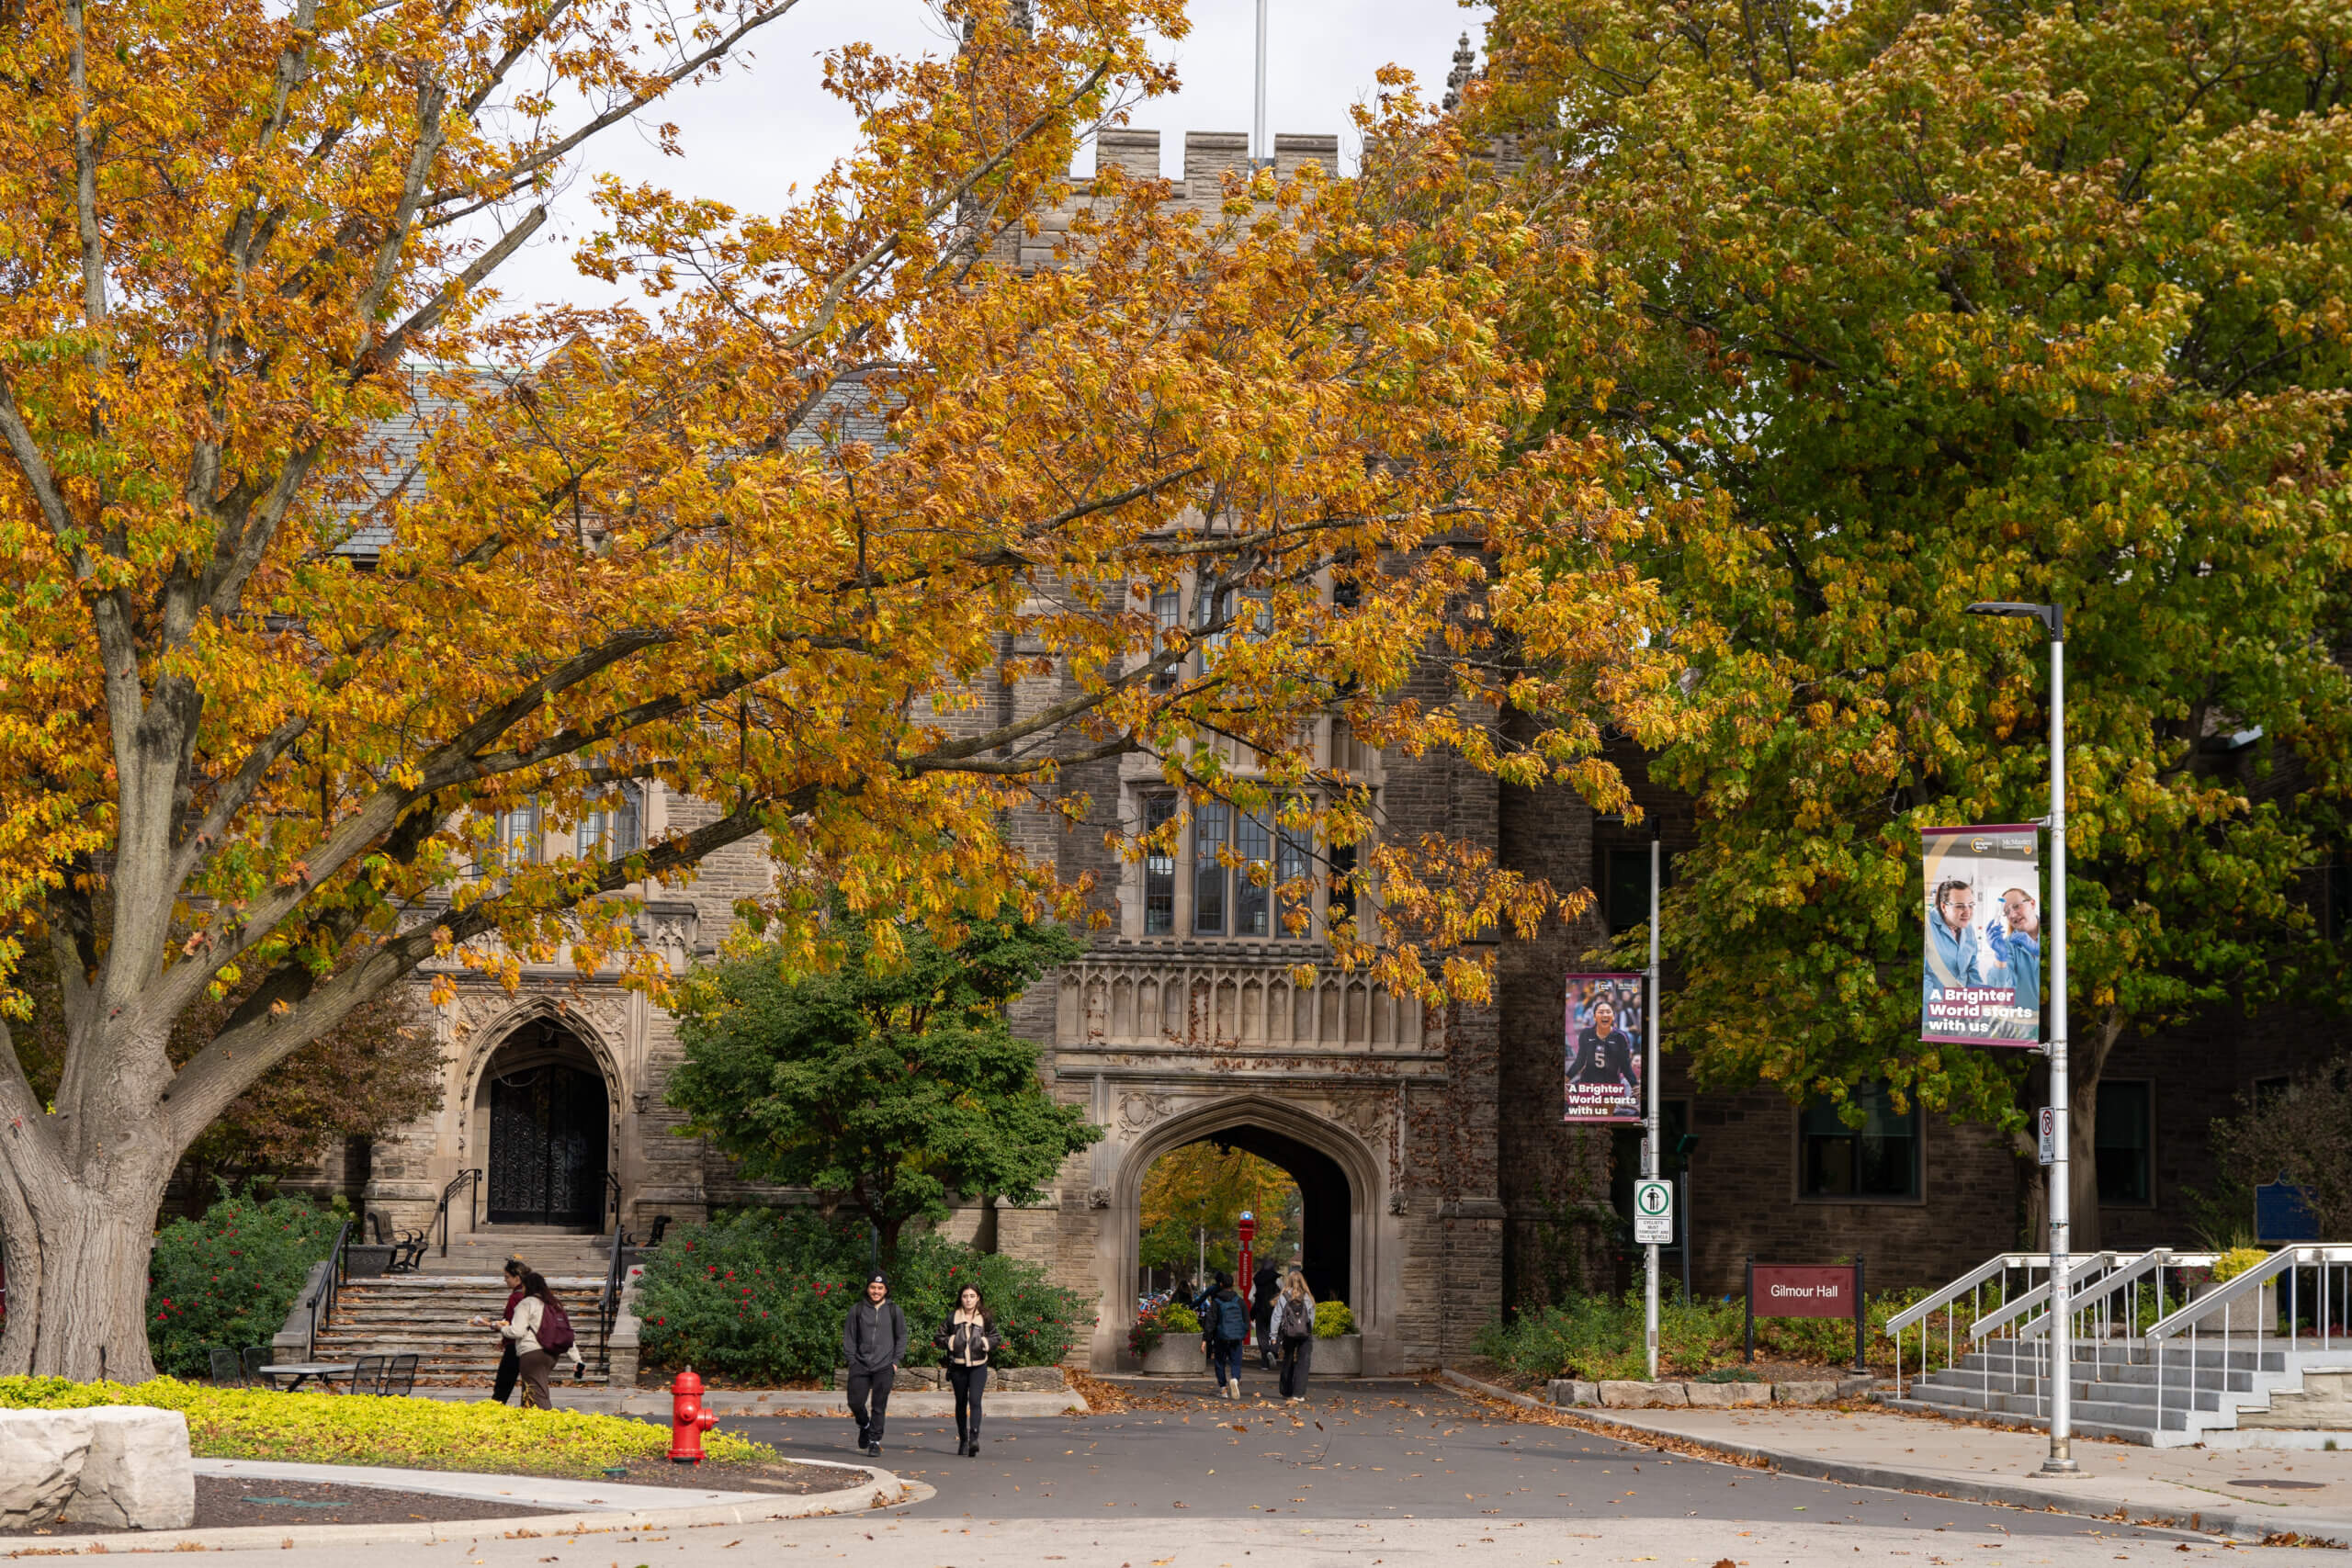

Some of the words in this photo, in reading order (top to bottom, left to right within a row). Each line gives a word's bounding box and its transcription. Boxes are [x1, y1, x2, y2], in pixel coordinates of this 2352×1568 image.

[1929, 988, 1941, 1000] A
[1945, 988, 2014, 1004] Brighter
[1929, 1004, 1980, 1017] World
[1983, 1006, 2032, 1019] starts
[1928, 1019, 1965, 1031] with
[1969, 1022, 1989, 1032] us
[1594, 1052, 1605, 1068] 5
[1568, 1084, 1577, 1093] A
[1578, 1083, 1624, 1095] Brighter
[1568, 1095, 1602, 1104] World
[1603, 1096, 1636, 1104] starts
[1568, 1106, 1593, 1115] with
[1594, 1107, 1609, 1115] us
[1770, 1284, 1814, 1297] Gilmour
[1816, 1285, 1838, 1297] Hall
